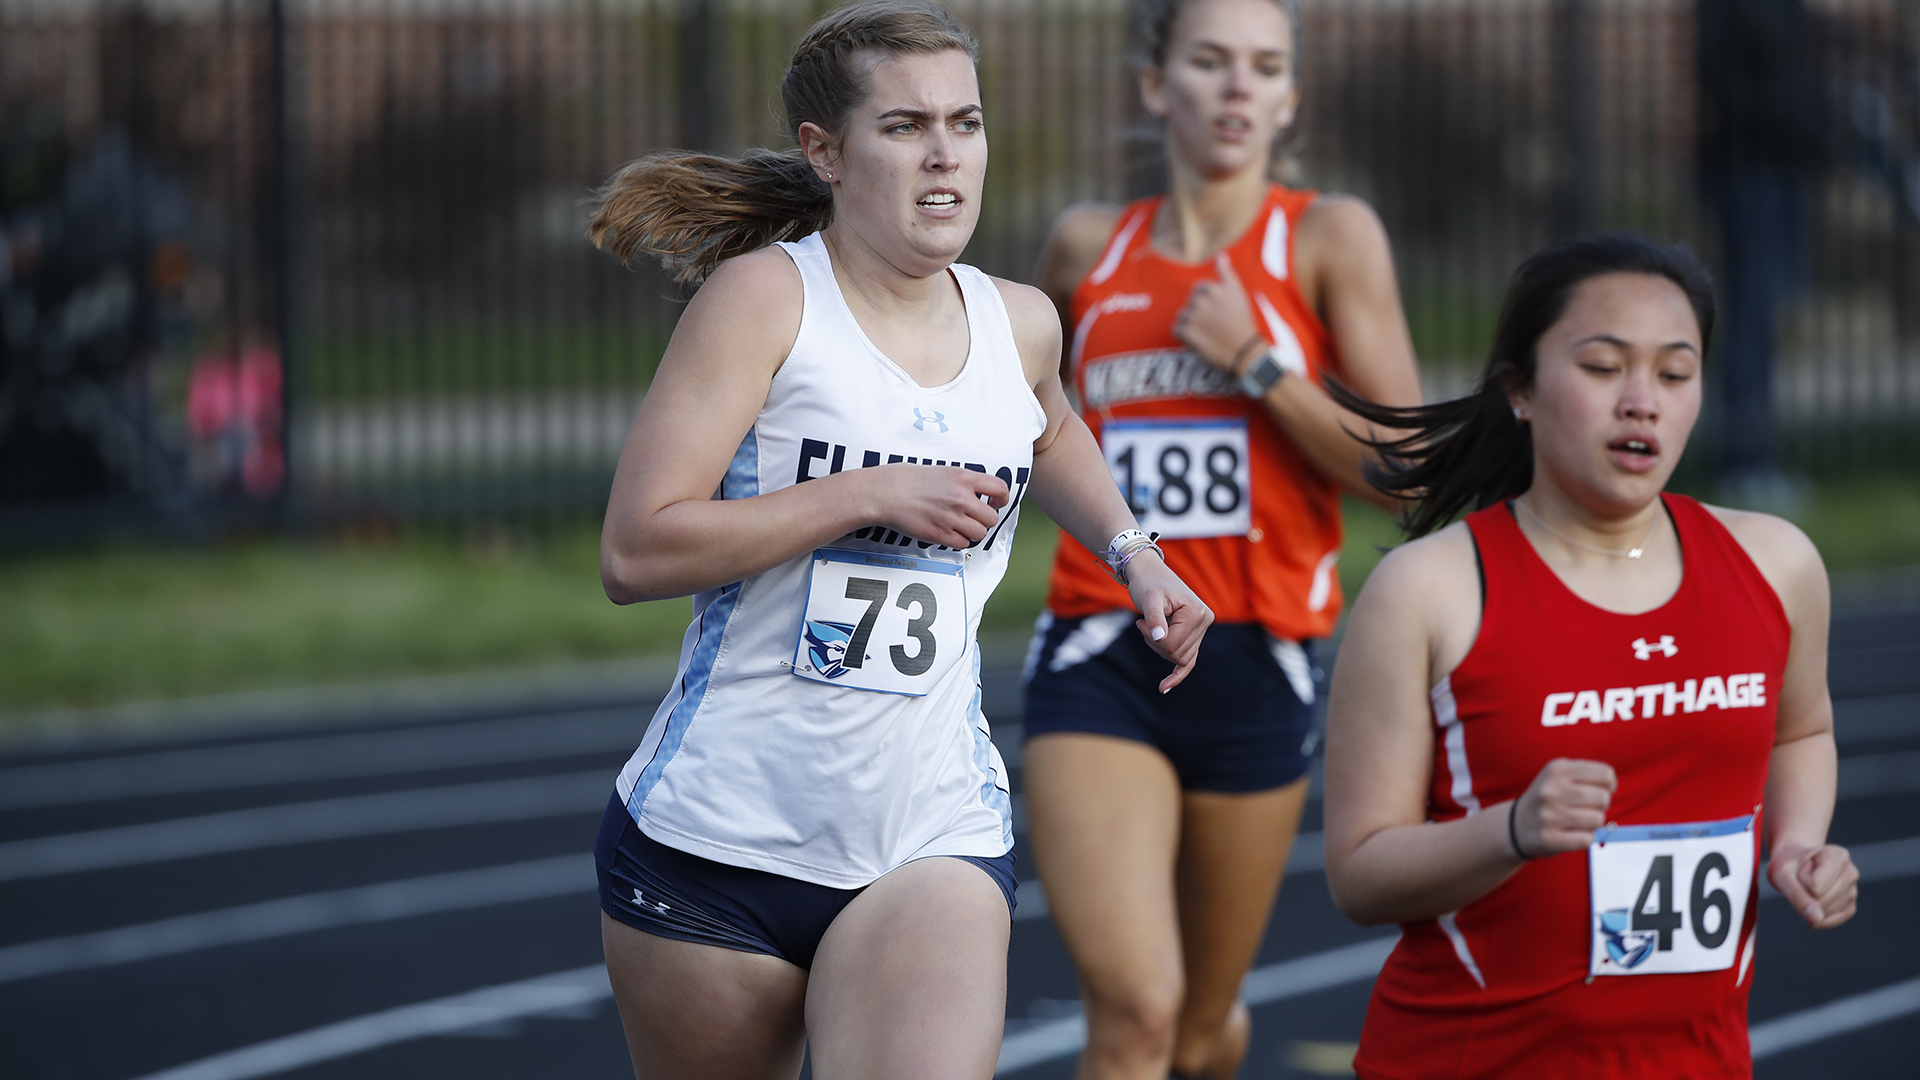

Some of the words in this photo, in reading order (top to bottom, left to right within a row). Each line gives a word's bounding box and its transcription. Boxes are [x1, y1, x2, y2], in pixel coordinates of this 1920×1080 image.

[1115, 444, 1241, 516] 188
[841, 576, 938, 677] 73
[1541, 673, 1766, 728] CARTHAGE
[1631, 851, 1732, 953] 46
